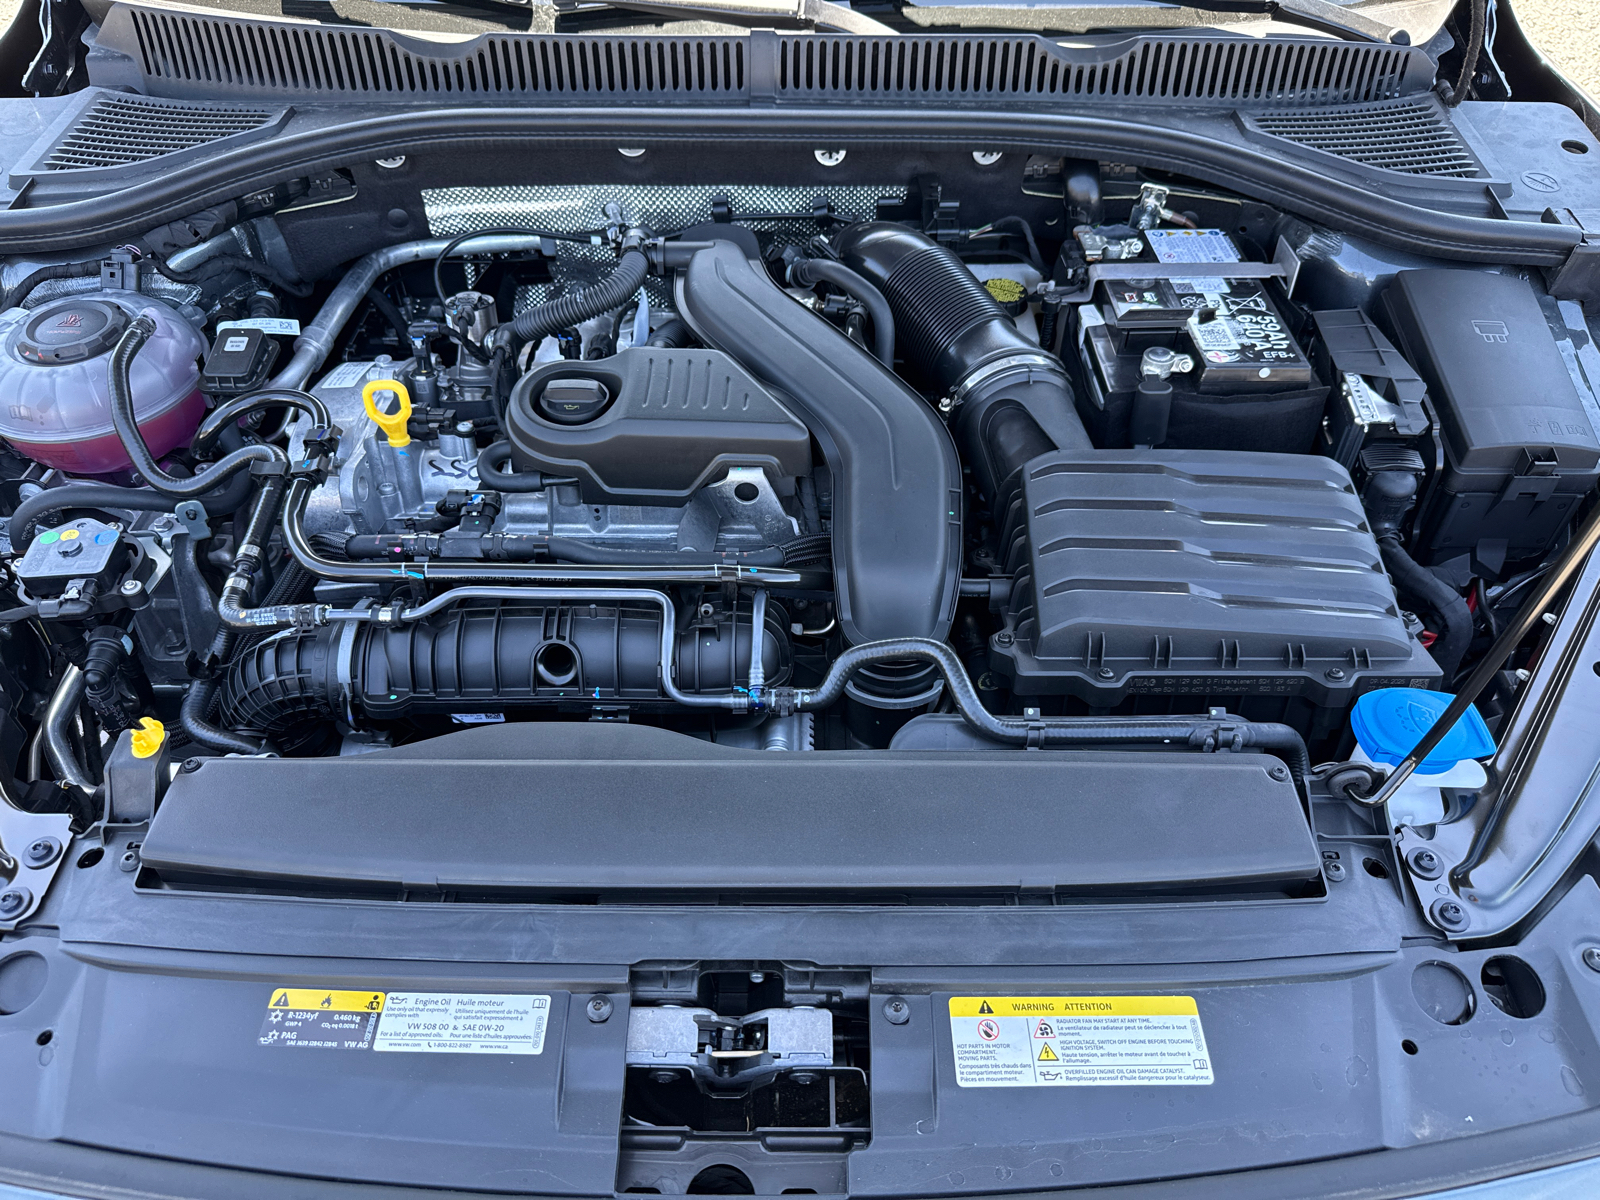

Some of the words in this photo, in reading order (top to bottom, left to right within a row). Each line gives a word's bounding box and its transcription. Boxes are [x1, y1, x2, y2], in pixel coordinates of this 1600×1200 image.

[1257, 316, 1290, 349] 59Ah
[415, 998, 439, 1006] Engine
[1012, 1003, 1054, 1011] WARNING
[288, 1012, 319, 1022] R-1234yf
[352, 1014, 361, 1022] kg
[281, 1032, 298, 1040] PAG
